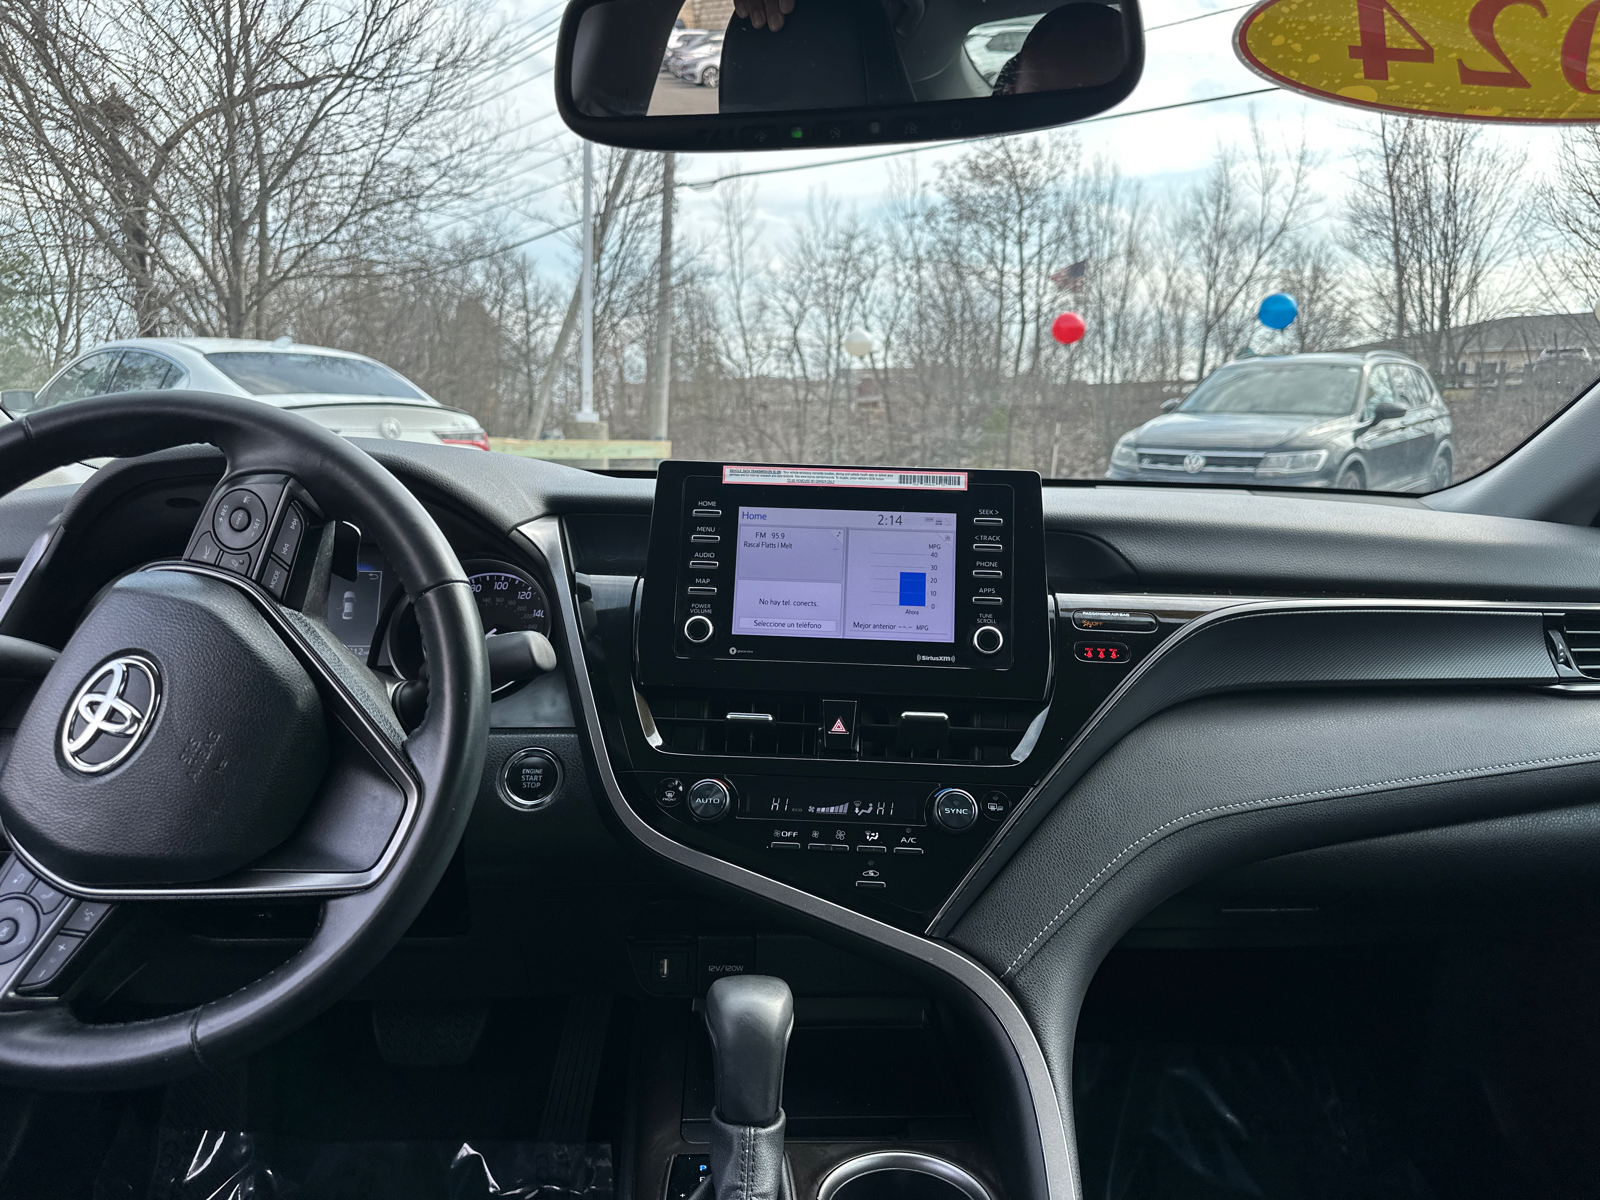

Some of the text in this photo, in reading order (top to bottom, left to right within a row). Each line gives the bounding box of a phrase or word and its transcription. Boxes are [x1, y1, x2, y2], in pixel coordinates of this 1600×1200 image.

[742, 511, 767, 520] Home
[877, 514, 903, 525] 2:14
[270, 570, 280, 589] MODE
[494, 582, 508, 590] 100
[517, 591, 531, 599] 120
[770, 599, 781, 607] hay
[754, 620, 786, 628] Seleccione
[796, 621, 822, 629] teléfono
[853, 622, 871, 630] Mejor
